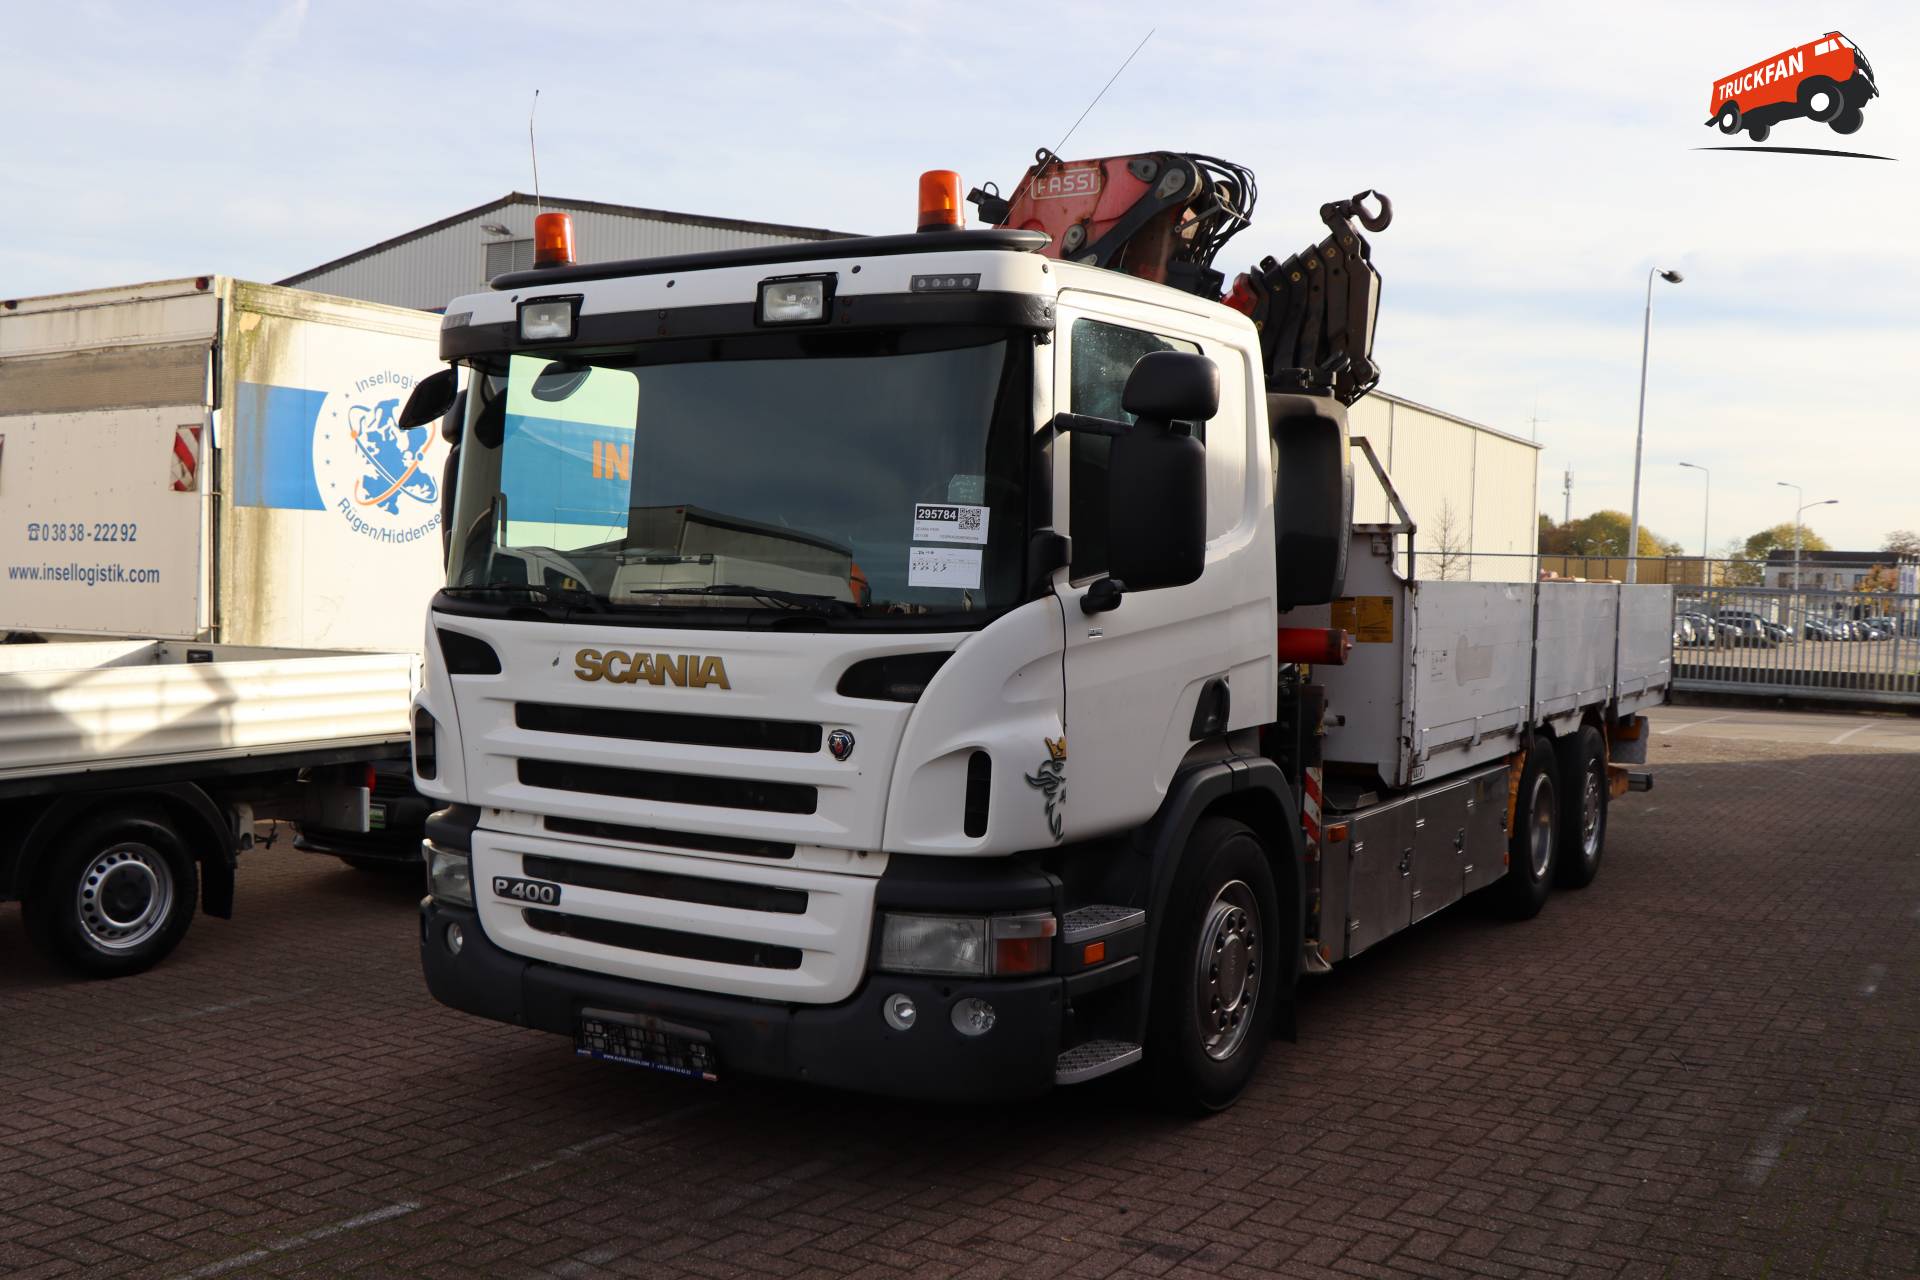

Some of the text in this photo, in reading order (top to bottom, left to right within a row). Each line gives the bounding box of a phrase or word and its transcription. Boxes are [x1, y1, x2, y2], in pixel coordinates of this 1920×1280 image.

[1038, 173, 1095, 194] FASSI
[593, 440, 630, 481] IN
[918, 508, 957, 521] 295784
[8, 563, 161, 586] www.insellogistik.com
[574, 648, 732, 690] SCANIA
[511, 882, 555, 903] 400
